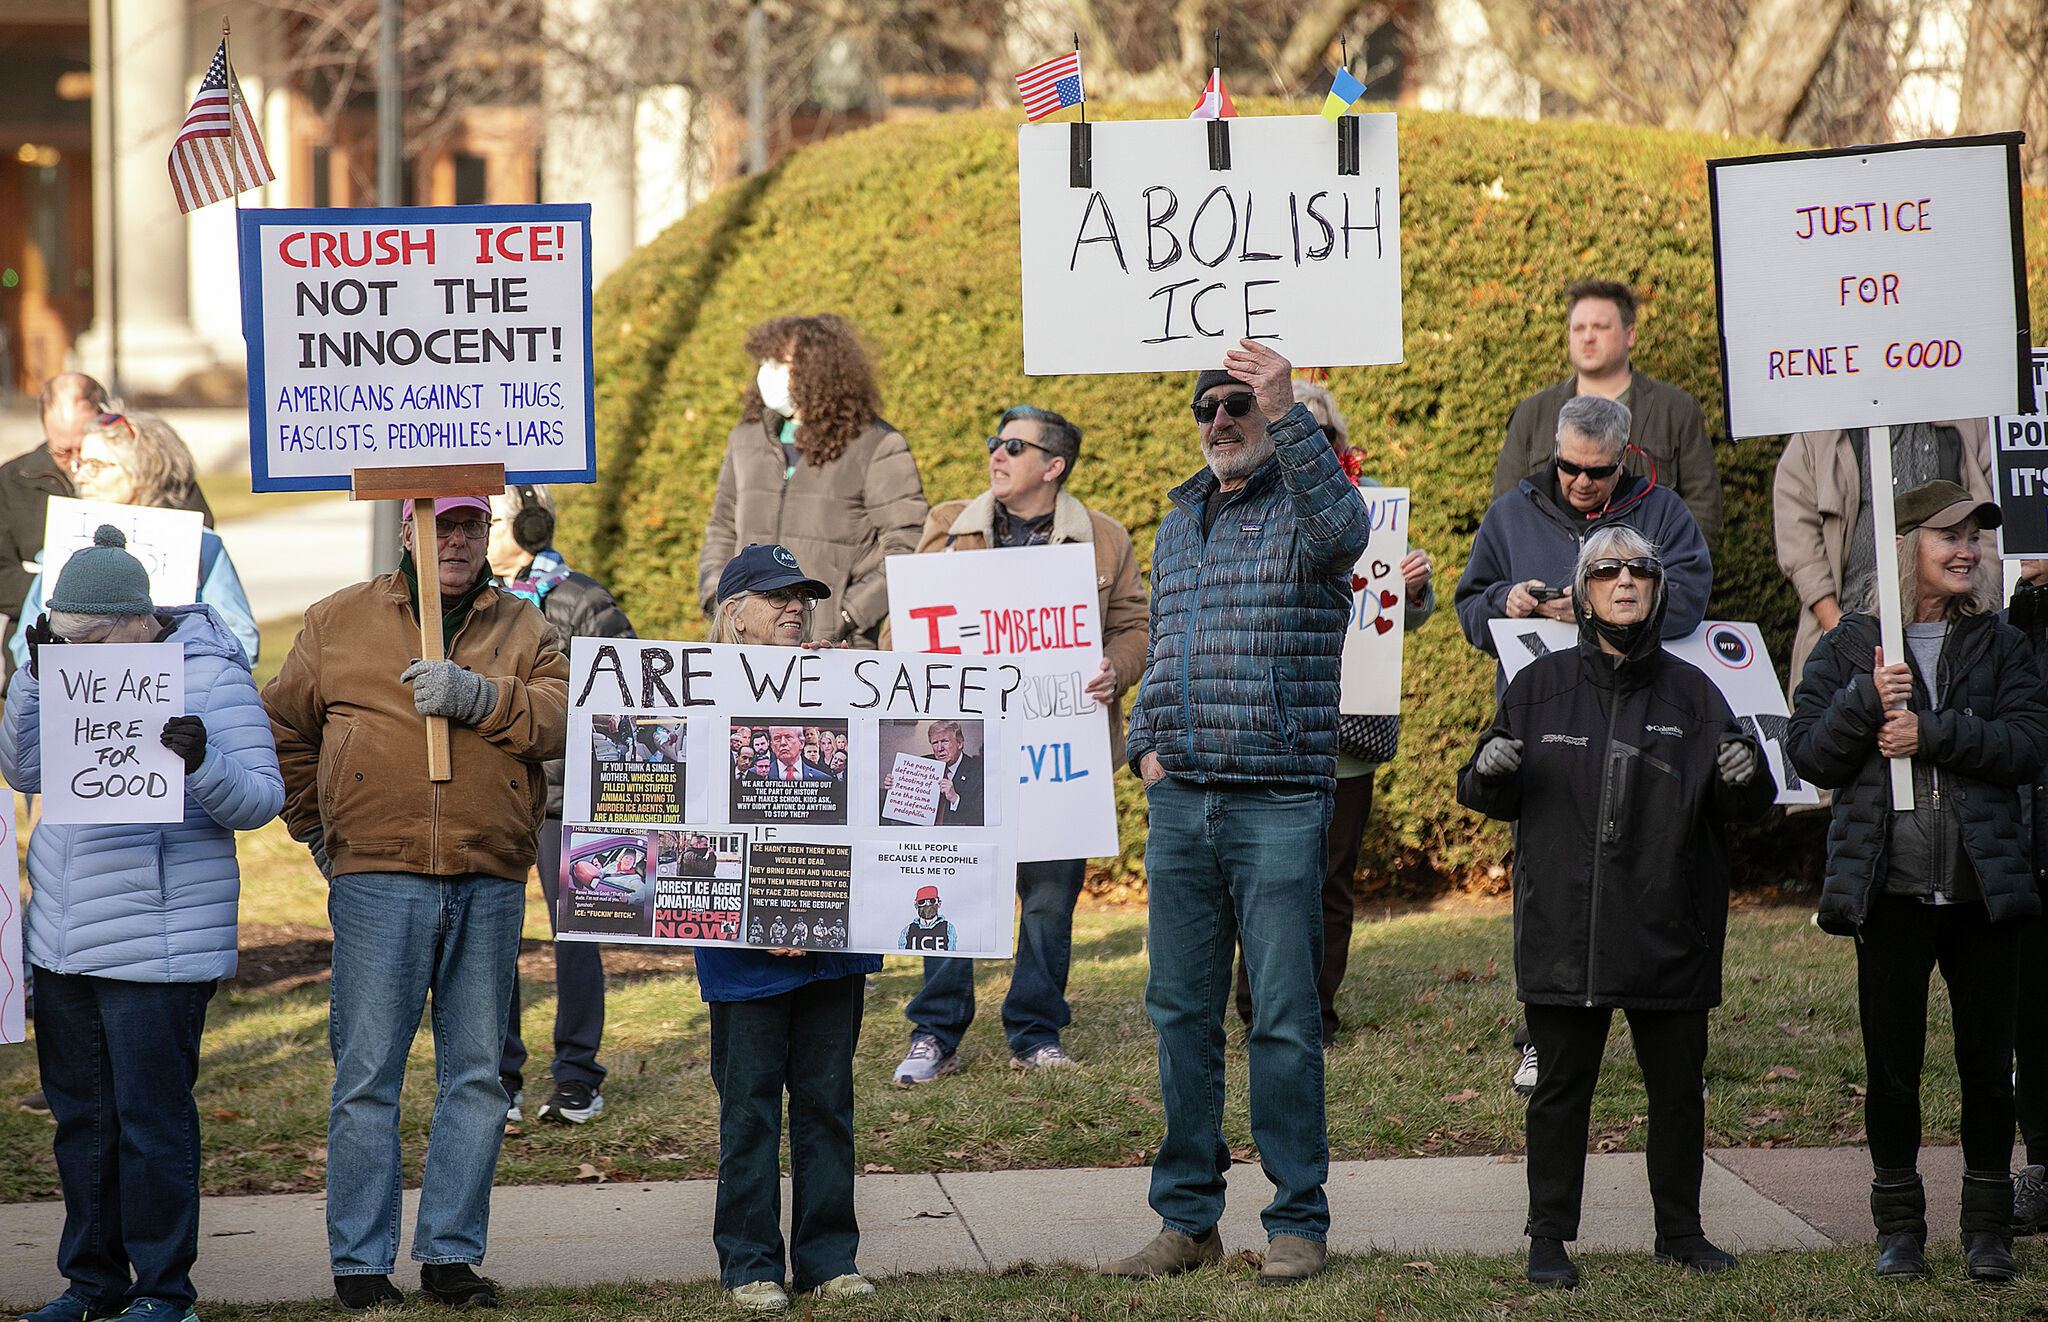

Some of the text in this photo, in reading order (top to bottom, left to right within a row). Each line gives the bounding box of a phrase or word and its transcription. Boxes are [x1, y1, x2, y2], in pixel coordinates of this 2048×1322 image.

[1796, 198, 1931, 240] JUSTICE
[1070, 186, 1381, 274] ABOLISH
[279, 226, 564, 268] CRUSH ICE!
[297, 278, 528, 316] NOT THE
[1840, 274, 1899, 306] FOR
[1140, 278, 1283, 344] ICE
[299, 327, 561, 368] INNOCENT!
[1769, 340, 1962, 380] RENEE GOOD
[278, 382, 565, 412] AMERICANS AGAINST THUGS,
[280, 424, 378, 452] FASCISTS,
[388, 422, 491, 450] PEDOPHILES
[506, 420, 564, 447] LIARS
[1370, 498, 1406, 531] UT
[909, 605, 961, 654] I
[980, 604, 1092, 655] IMBECILE
[61, 669, 171, 704] WE ARE
[576, 645, 1021, 720] ARE WE SAFE?
[1023, 671, 1097, 721] RUEL
[74, 718, 142, 746] HERE
[94, 746, 140, 768] FOR
[602, 763, 675, 772] IF YOU THINK A SINGLE
[895, 767, 928, 780] defending
[915, 763, 936, 772] people
[71, 767, 168, 799] GOOD
[600, 773, 676, 782] MOTHER, WHOSE CAR IS
[899, 776, 924, 787] shooting
[603, 783, 673, 792] FILLED WITH STUFFED
[895, 783, 931, 795] Renee Good
[634, 794, 640, 802] IS
[642, 794, 665, 803] TRYING
[666, 794, 675, 803] TO
[597, 803, 624, 812] MURDER
[626, 804, 636, 812] ICE
[666, 804, 679, 813] YOU
[904, 801, 936, 813] defending
[594, 813, 607, 822] ARE
[608, 813, 613, 822] A
[615, 814, 662, 822] BRAINWASHED
[755, 826, 776, 840] IF
[925, 844, 958, 852] PEOPLE
[929, 856, 978, 864] PEDOPHILE
[656, 881, 742, 895] ARREST ICE AGENT
[656, 894, 741, 910] JONATHAN ROSS
[753, 898, 778, 907] THEY'RE
[780, 899, 797, 907] 100%
[799, 900, 810, 908] THE
[656, 909, 740, 922] MURDER
[655, 922, 739, 939] NOW!
[912, 936, 944, 951] ICE
